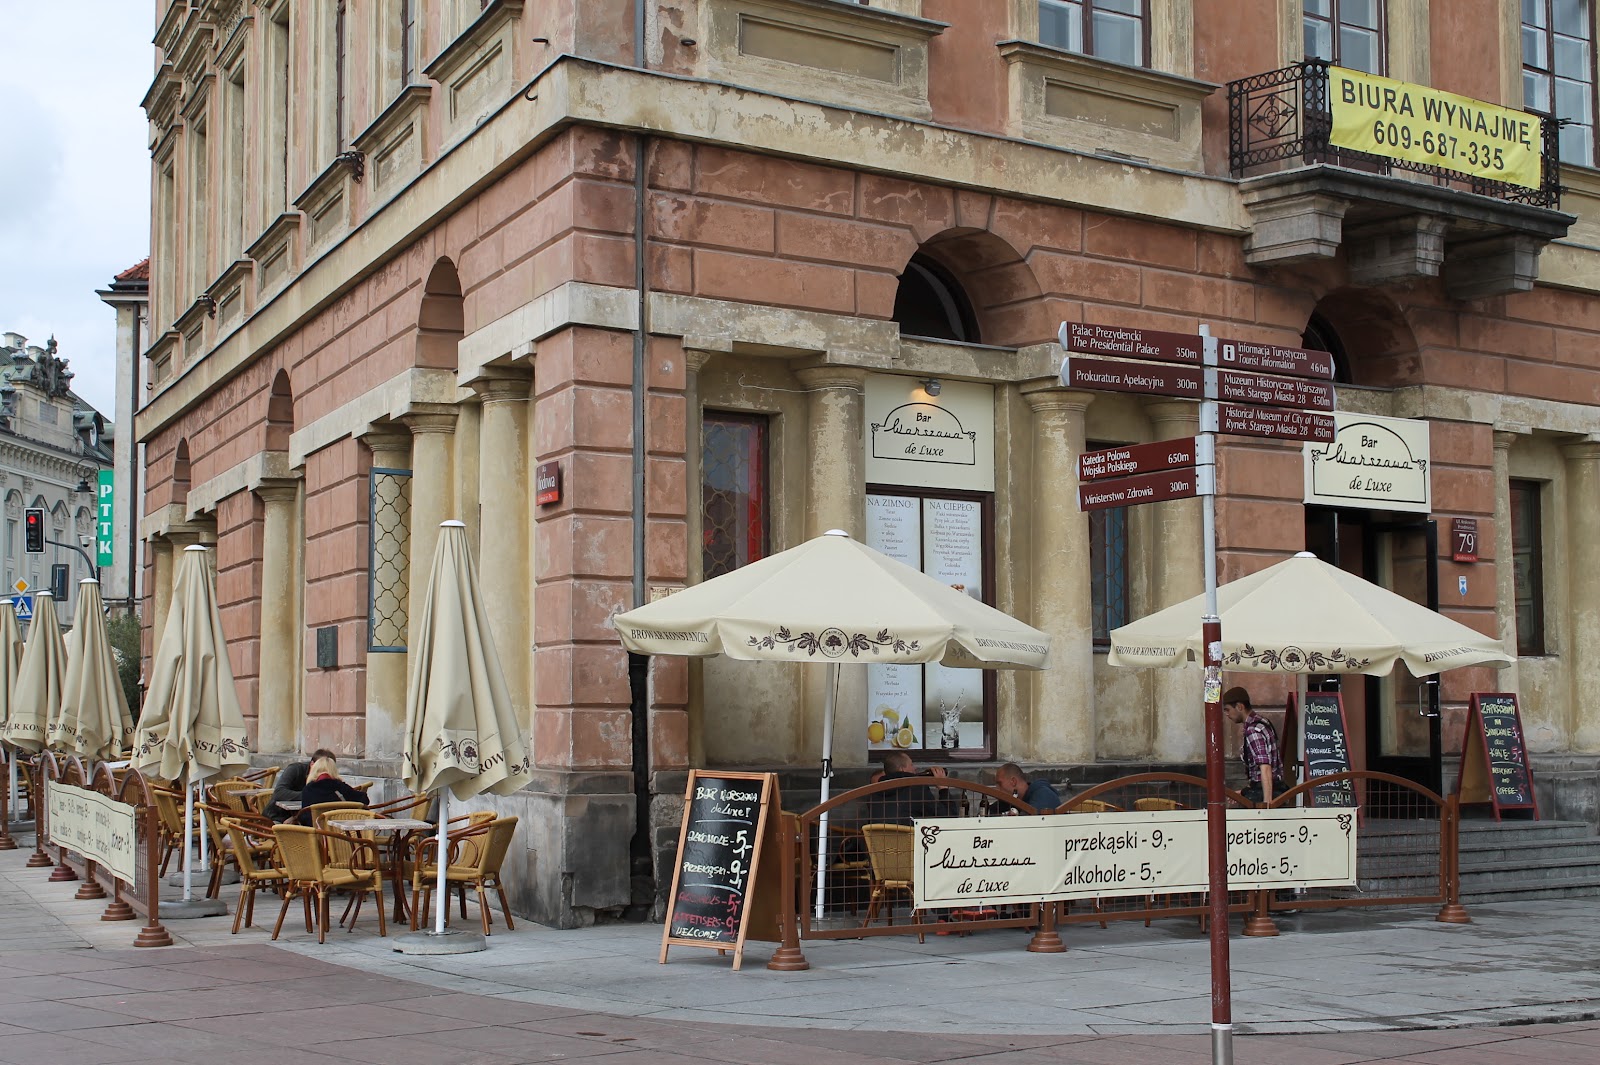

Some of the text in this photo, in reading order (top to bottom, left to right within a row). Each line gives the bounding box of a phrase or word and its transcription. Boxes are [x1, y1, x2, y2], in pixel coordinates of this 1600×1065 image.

[1341, 79, 1531, 151] BIURA WYNAJMĘ
[1373, 120, 1505, 171] 609-687-335
[1072, 324, 1142, 342] Pałac Prezydencki
[1072, 336, 1160, 355] The Presidential Palace
[1176, 347, 1198, 359] 350m
[1238, 342, 1308, 360] Informacja Turystyczna
[1238, 354, 1296, 370] Tourist Information
[1310, 363, 1330, 374] 460m
[1076, 370, 1198, 390] Prokuratura Apelacyjna 300m
[1224, 373, 1328, 398] Muzeum Historyczne Warszawy
[1224, 384, 1331, 407] Rynek Starego Miasta 28 450m
[916, 412, 932, 423] Bar
[1225, 406, 1334, 427] Historical Museum of City of Warsaw
[884, 418, 964, 440] Warszawa
[1226, 418, 1332, 438] Rynek Starego Miasta 28 450m
[904, 442, 944, 457] de Luxe
[1361, 435, 1378, 449] Bar
[1082, 450, 1130, 466] Katedra Polowa
[1168, 452, 1190, 464] 650m
[1326, 443, 1414, 470] Warszawa
[1083, 460, 1138, 478] Wojska Polskiego
[1084, 481, 1189, 505] Ministerstwo Zdrowia 300m
[1349, 475, 1392, 493] de Luxe
[867, 498, 914, 509] NA ZIMNO:
[929, 502, 942, 510] NA
[100, 484, 112, 554] PTTK
[1458, 533, 1474, 554] 79
[631, 629, 664, 640] BROWAR
[1424, 648, 1461, 663] BROWAR
[696, 786, 718, 801] BAR
[1332, 792, 1343, 805] 24
[973, 836, 993, 849] Bar
[1064, 830, 1138, 860] przekąski
[1228, 828, 1287, 852] petisers
[930, 848, 1036, 869] Warszawa
[1227, 858, 1268, 876] ohols
[1064, 864, 1126, 886] alkohole
[957, 878, 1009, 894] de Luxe
